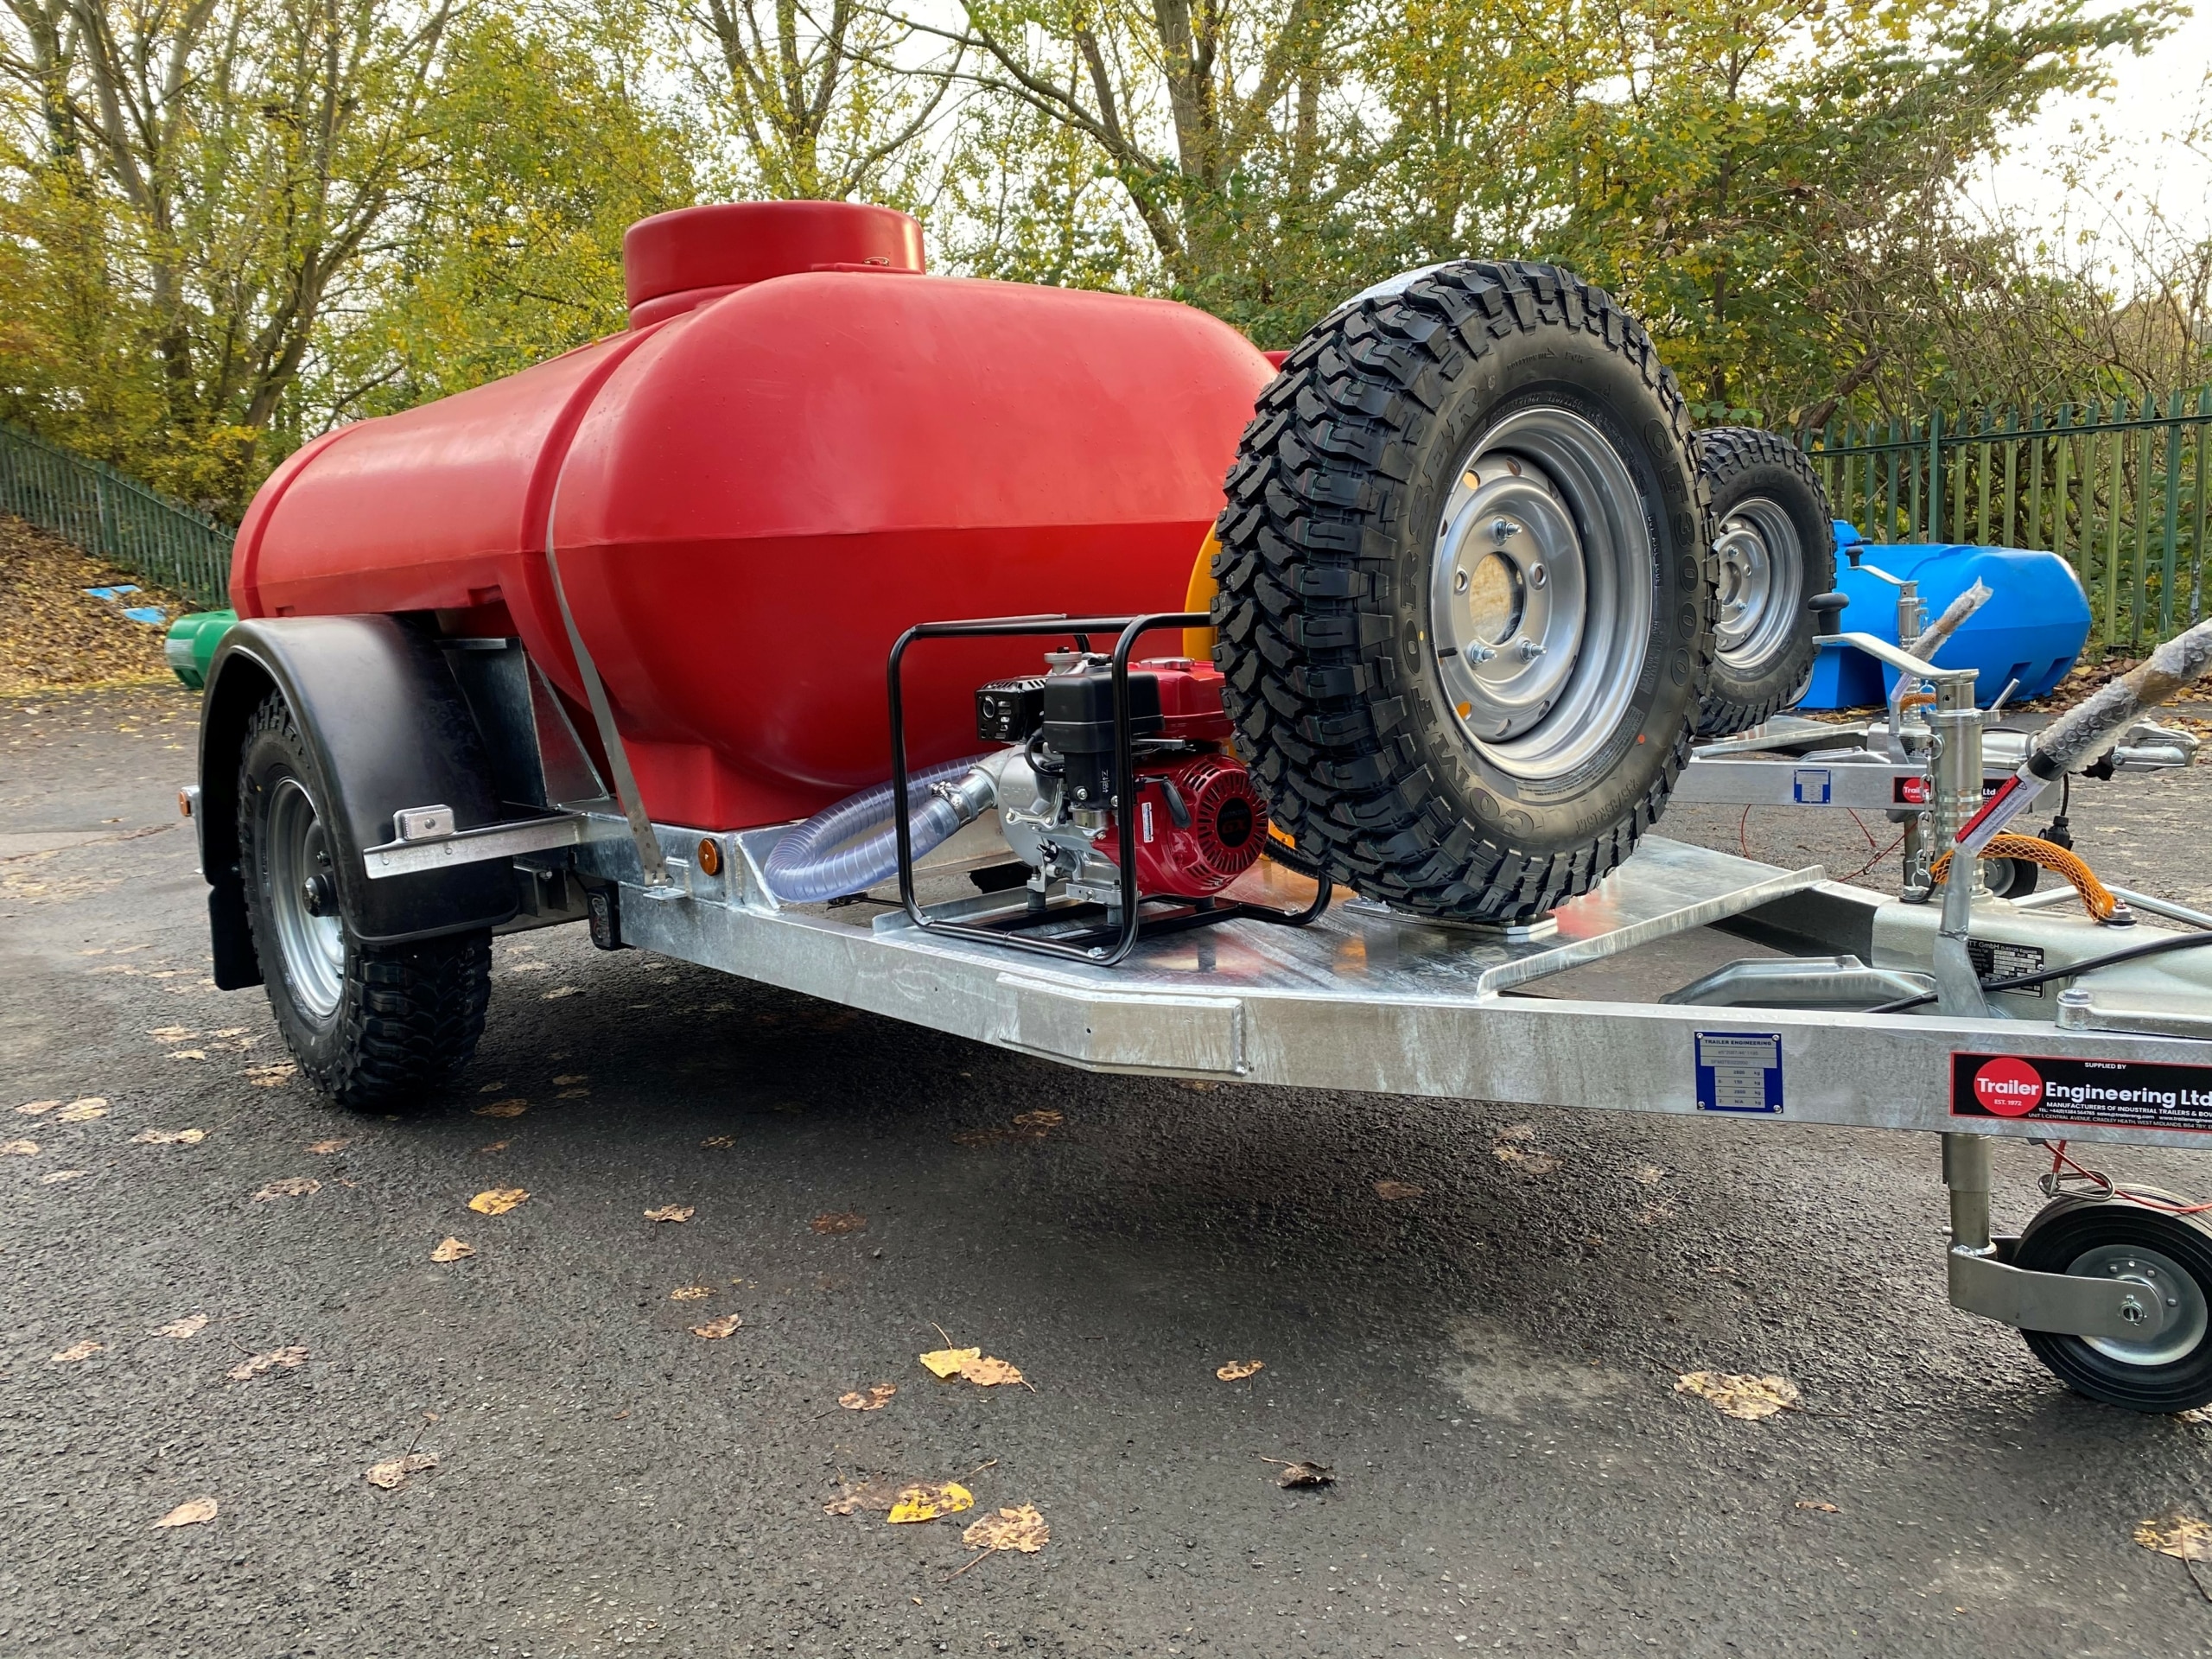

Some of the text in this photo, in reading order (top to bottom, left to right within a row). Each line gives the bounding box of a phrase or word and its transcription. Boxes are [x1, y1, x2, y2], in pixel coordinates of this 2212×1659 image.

[1644, 418, 1698, 687] CF3000
[1904, 785, 1929, 794] Trailr
[1977, 1077, 2040, 1096] Trailer
[2045, 1081, 2212, 1109] Engineering Ltd
[2046, 1102, 2106, 1110] MANUFACTURERS
